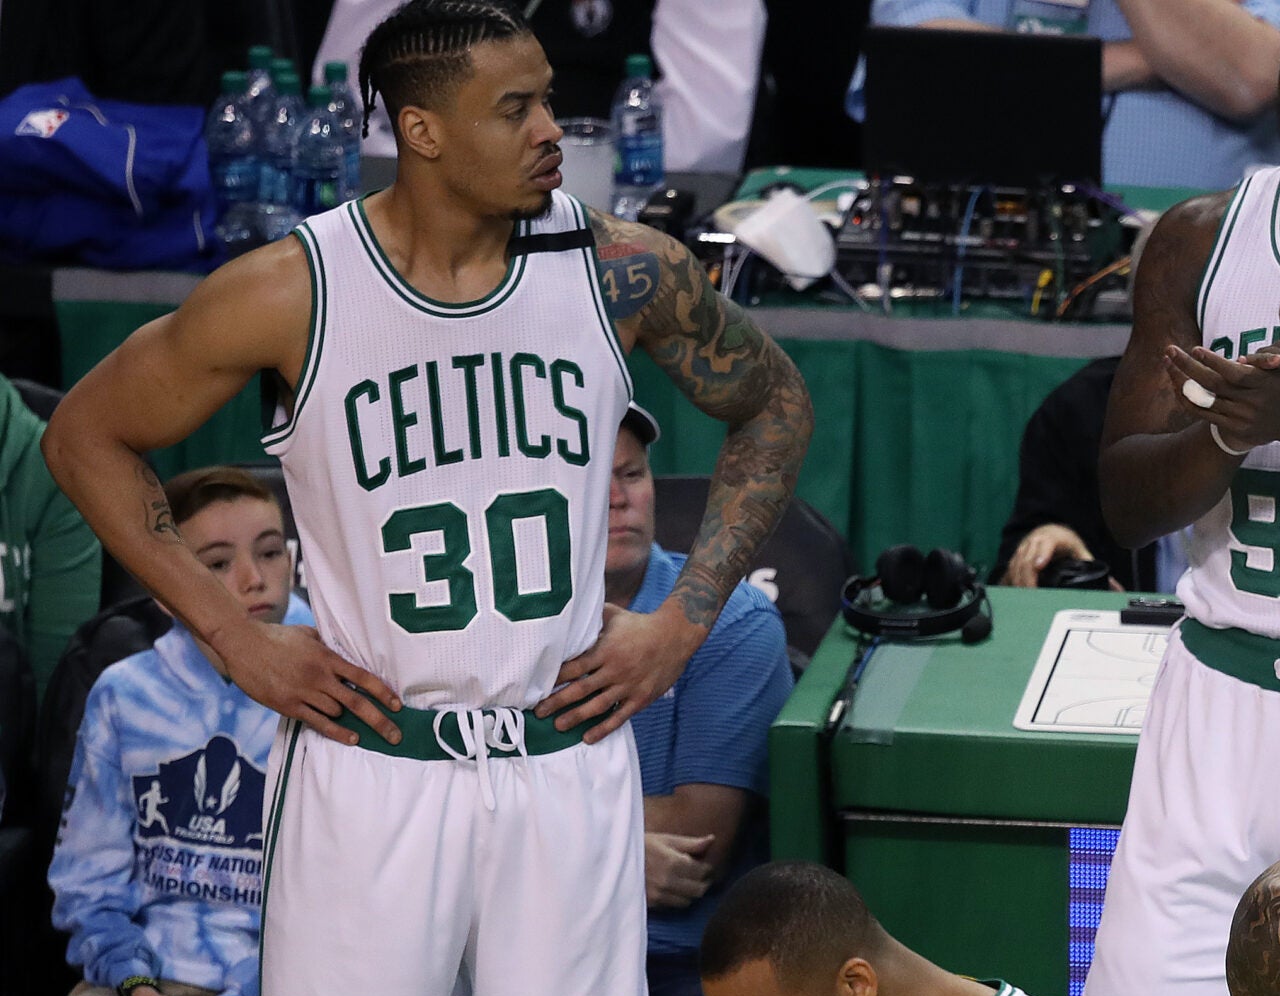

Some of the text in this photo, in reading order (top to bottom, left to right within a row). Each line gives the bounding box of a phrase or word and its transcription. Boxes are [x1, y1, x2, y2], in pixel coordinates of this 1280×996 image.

[344, 351, 591, 492] CELTICS
[380, 487, 574, 634] 30
[188, 814, 226, 835] USA
